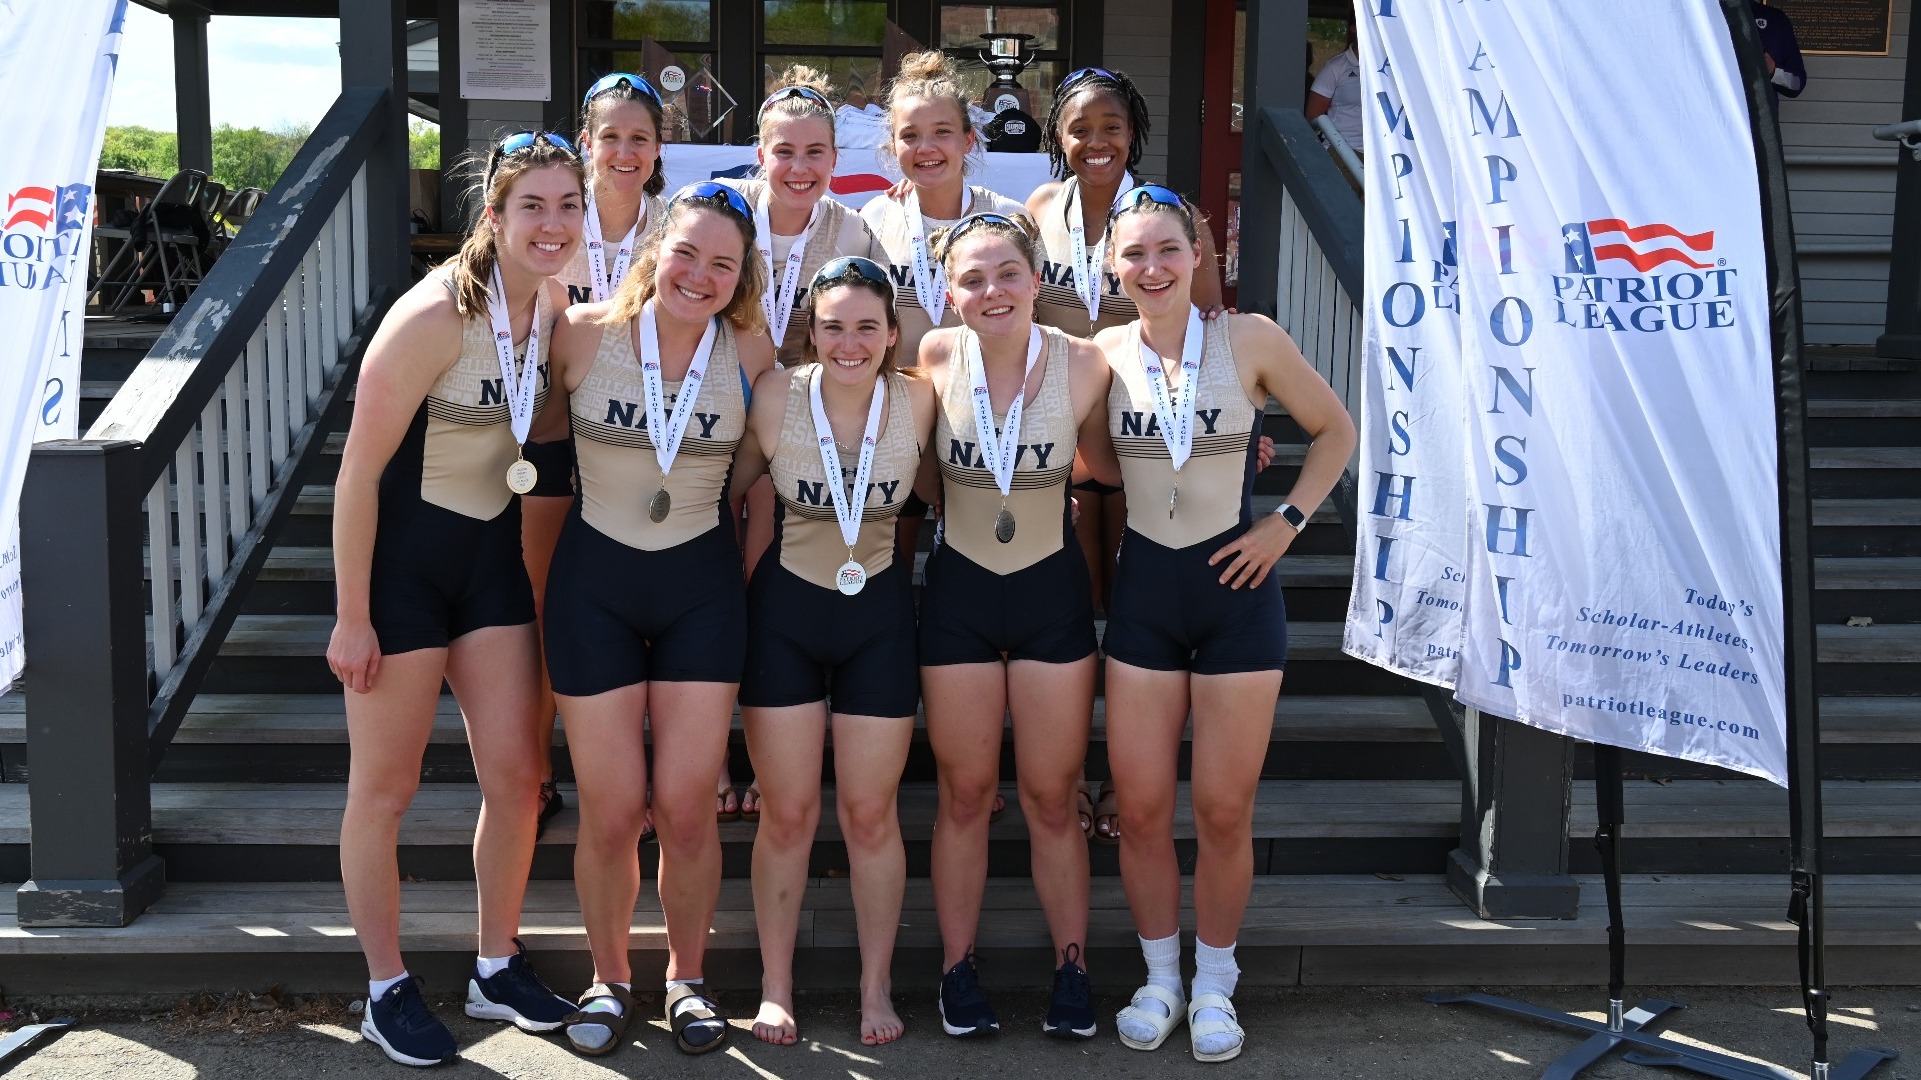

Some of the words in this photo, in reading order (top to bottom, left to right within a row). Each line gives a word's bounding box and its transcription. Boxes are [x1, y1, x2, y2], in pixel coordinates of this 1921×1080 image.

[1040, 260, 1121, 295] NAY
[1550, 269, 1738, 303] PATRIOT
[1553, 300, 1736, 333] LEAGUE
[479, 360, 549, 406] NY
[650, 376, 659, 413] PATRIOT
[1121, 408, 1222, 437] NAY
[1685, 588, 1754, 617] Today's
[1576, 606, 1755, 654] Scholar-Athletes,
[1545, 634, 1670, 666] Tomorrow's
[1677, 653, 1759, 685] Leaders
[1562, 693, 1760, 740] patriotleague.com
